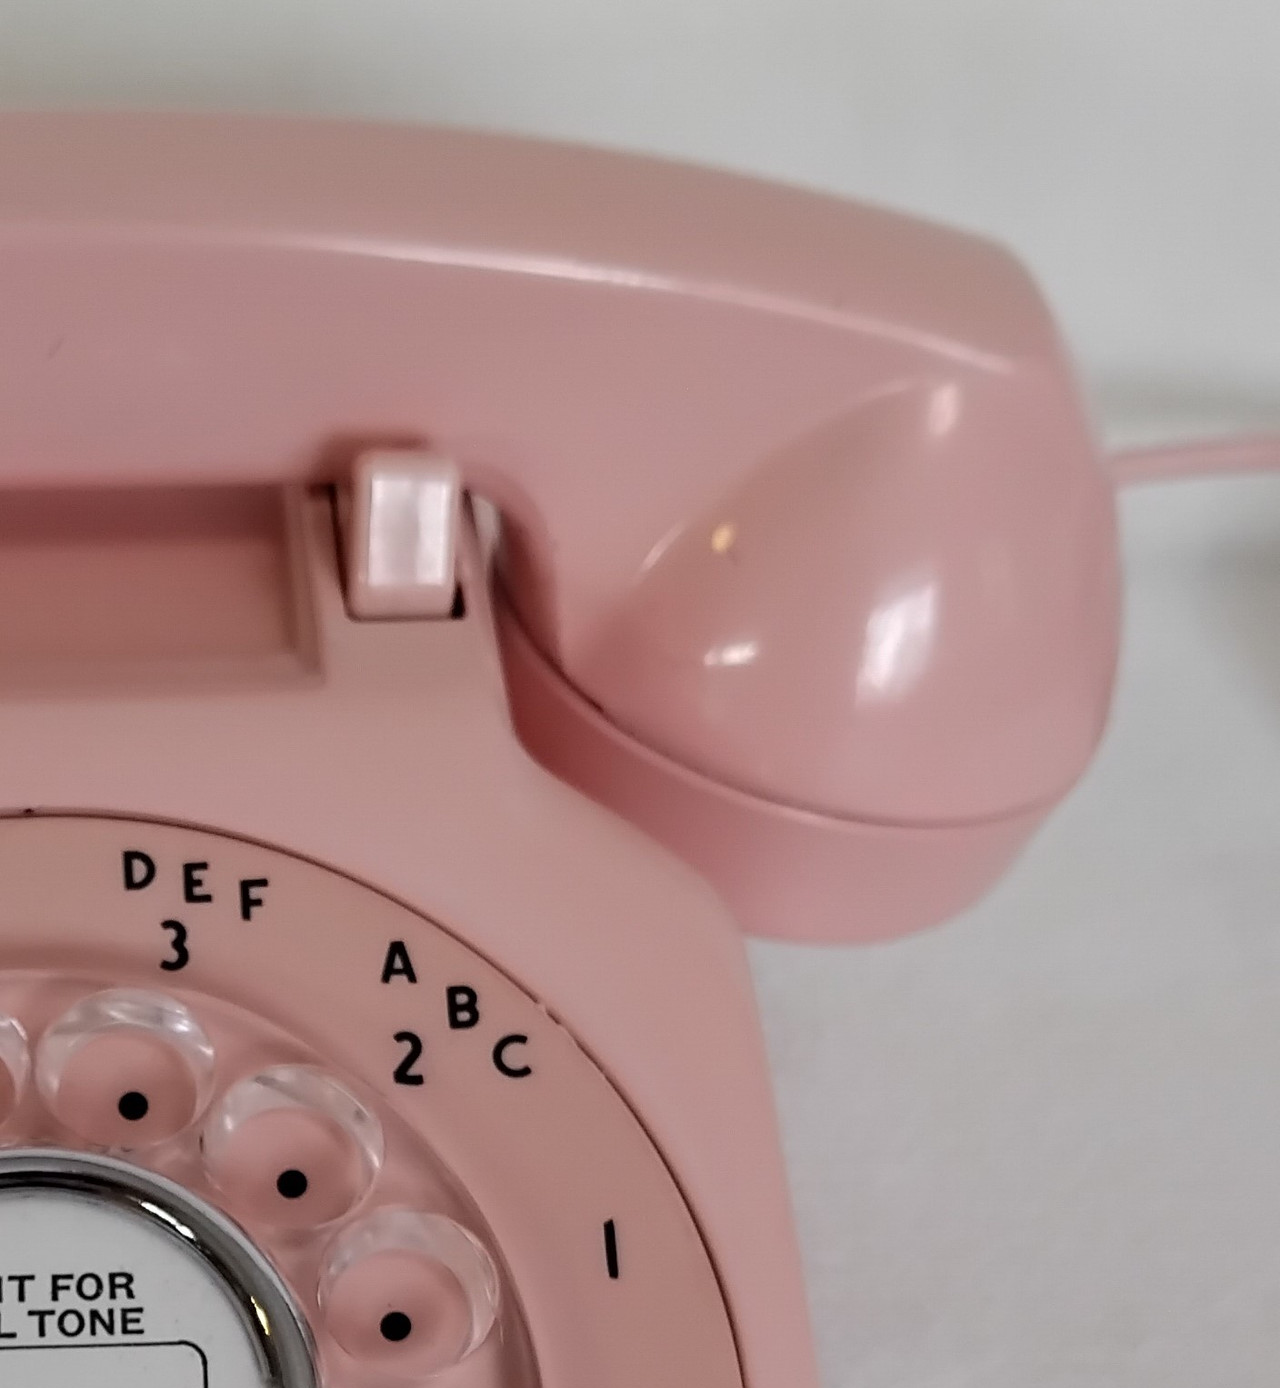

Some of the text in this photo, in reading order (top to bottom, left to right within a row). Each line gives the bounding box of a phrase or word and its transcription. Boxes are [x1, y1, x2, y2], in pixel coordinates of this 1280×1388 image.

[120, 848, 271, 923] D E F
[157, 917, 192, 974] 3
[379, 939, 534, 1080] A B C
[391, 1029, 426, 1088] 2
[49, 1270, 137, 1304] FOR
[26, 1305, 146, 1341] TONE
